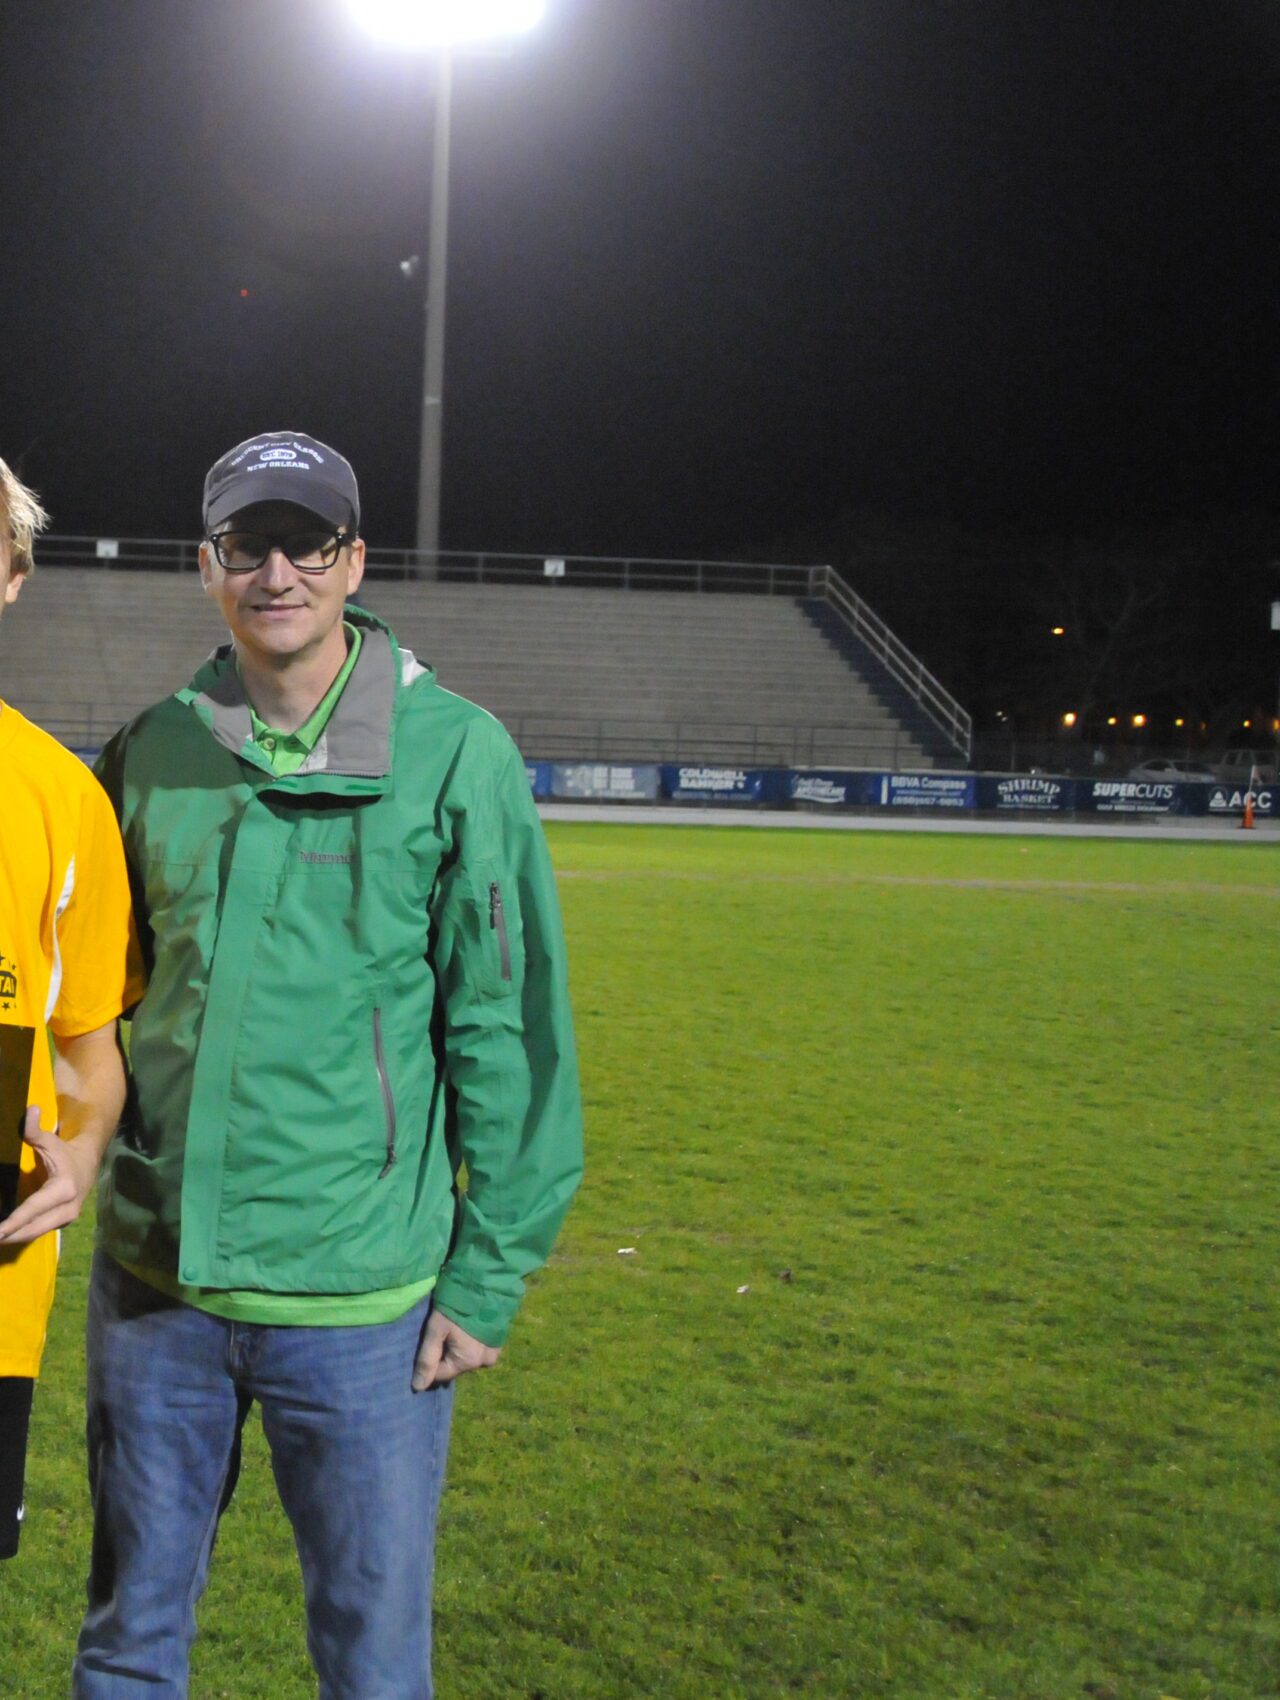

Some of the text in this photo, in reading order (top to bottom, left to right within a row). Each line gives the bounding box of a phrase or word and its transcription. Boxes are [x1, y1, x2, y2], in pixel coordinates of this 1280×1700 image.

[247, 461, 310, 472] NEW ORLEANS
[679, 768, 746, 780] COLDWELL
[679, 778, 734, 790] BANKER
[891, 776, 967, 791] BBVA Compass
[997, 778, 1061, 795] SHRIMP
[1092, 782, 1174, 799] SUPERCUTS
[1003, 794, 1055, 803] BASKET
